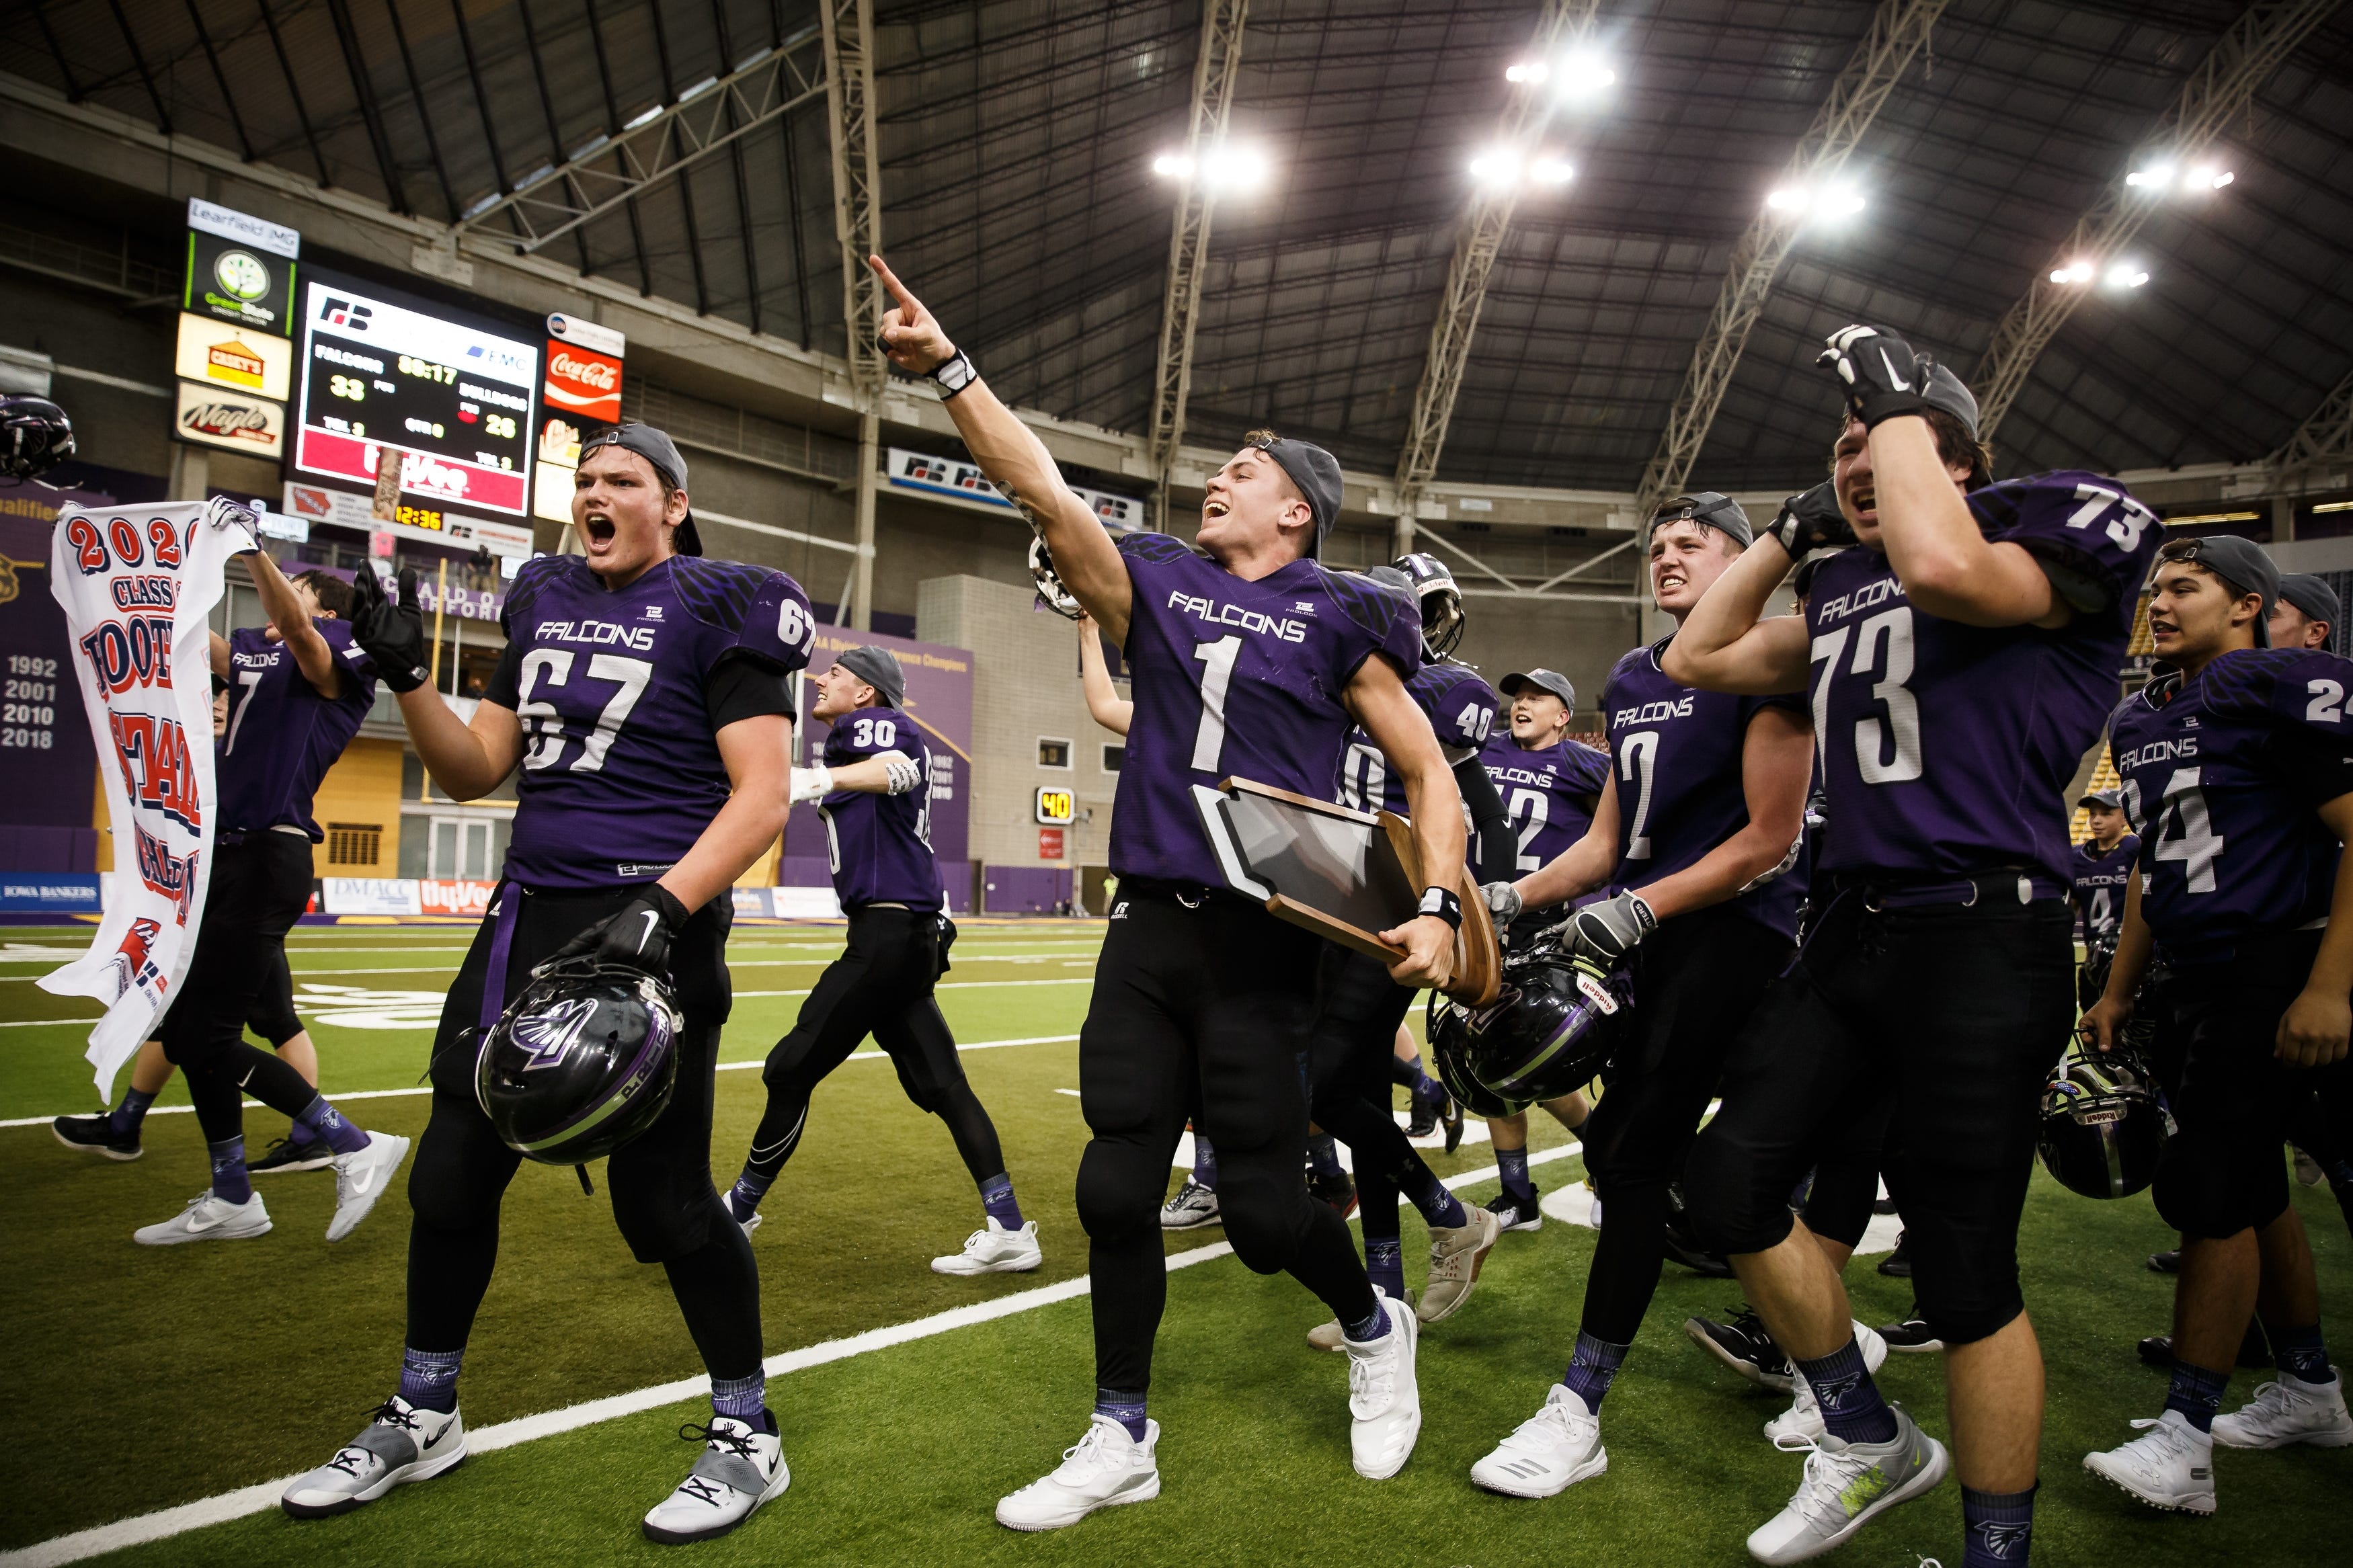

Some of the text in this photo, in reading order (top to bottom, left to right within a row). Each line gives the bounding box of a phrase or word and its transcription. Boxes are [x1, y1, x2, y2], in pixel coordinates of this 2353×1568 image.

[315, 344, 385, 374] FALCONS
[489, 350, 526, 370] EMC
[330, 375, 365, 401] 33
[184, 403, 265, 436] Nagle
[485, 414, 516, 439] 26
[395, 505, 442, 531] 12:36
[2066, 483, 2155, 552] 73
[110, 575, 175, 613] CLASS
[1417, 580, 1449, 593] Riddell
[1818, 575, 1907, 626] FALCON
[1168, 590, 1308, 643] FALCONS
[1285, 607, 1318, 618] PROLOOK
[535, 620, 655, 651] FALCONS
[777, 598, 817, 658] 67
[9, 655, 58, 678] 1992
[231, 651, 280, 668] FALCONS
[5, 679, 56, 702] 2001
[1191, 634, 1242, 773] 1
[1810, 606, 1923, 785] 73
[2307, 679, 2353, 723] 2
[3, 703, 54, 726] 2010
[225, 671, 264, 757] 7
[517, 648, 653, 772] 67
[1456, 702, 1494, 741] 40
[1613, 695, 1694, 730] FALCONS
[1, 727, 52, 749] 2018
[853, 718, 897, 748] 30
[2120, 737, 2198, 774] FALCONS
[1335, 743, 1385, 815] 0
[1042, 792, 1070, 819] 40
[1620, 731, 1659, 860] 2
[4, 885, 97, 899] IOWA BANKERS
[335, 880, 412, 897] DMACC
[2075, 874, 2127, 887] FALCONS
[2089, 888, 2115, 934] 4
[1581, 981, 1612, 1011] Riddell
[2086, 1112, 2116, 1123] Riddell
